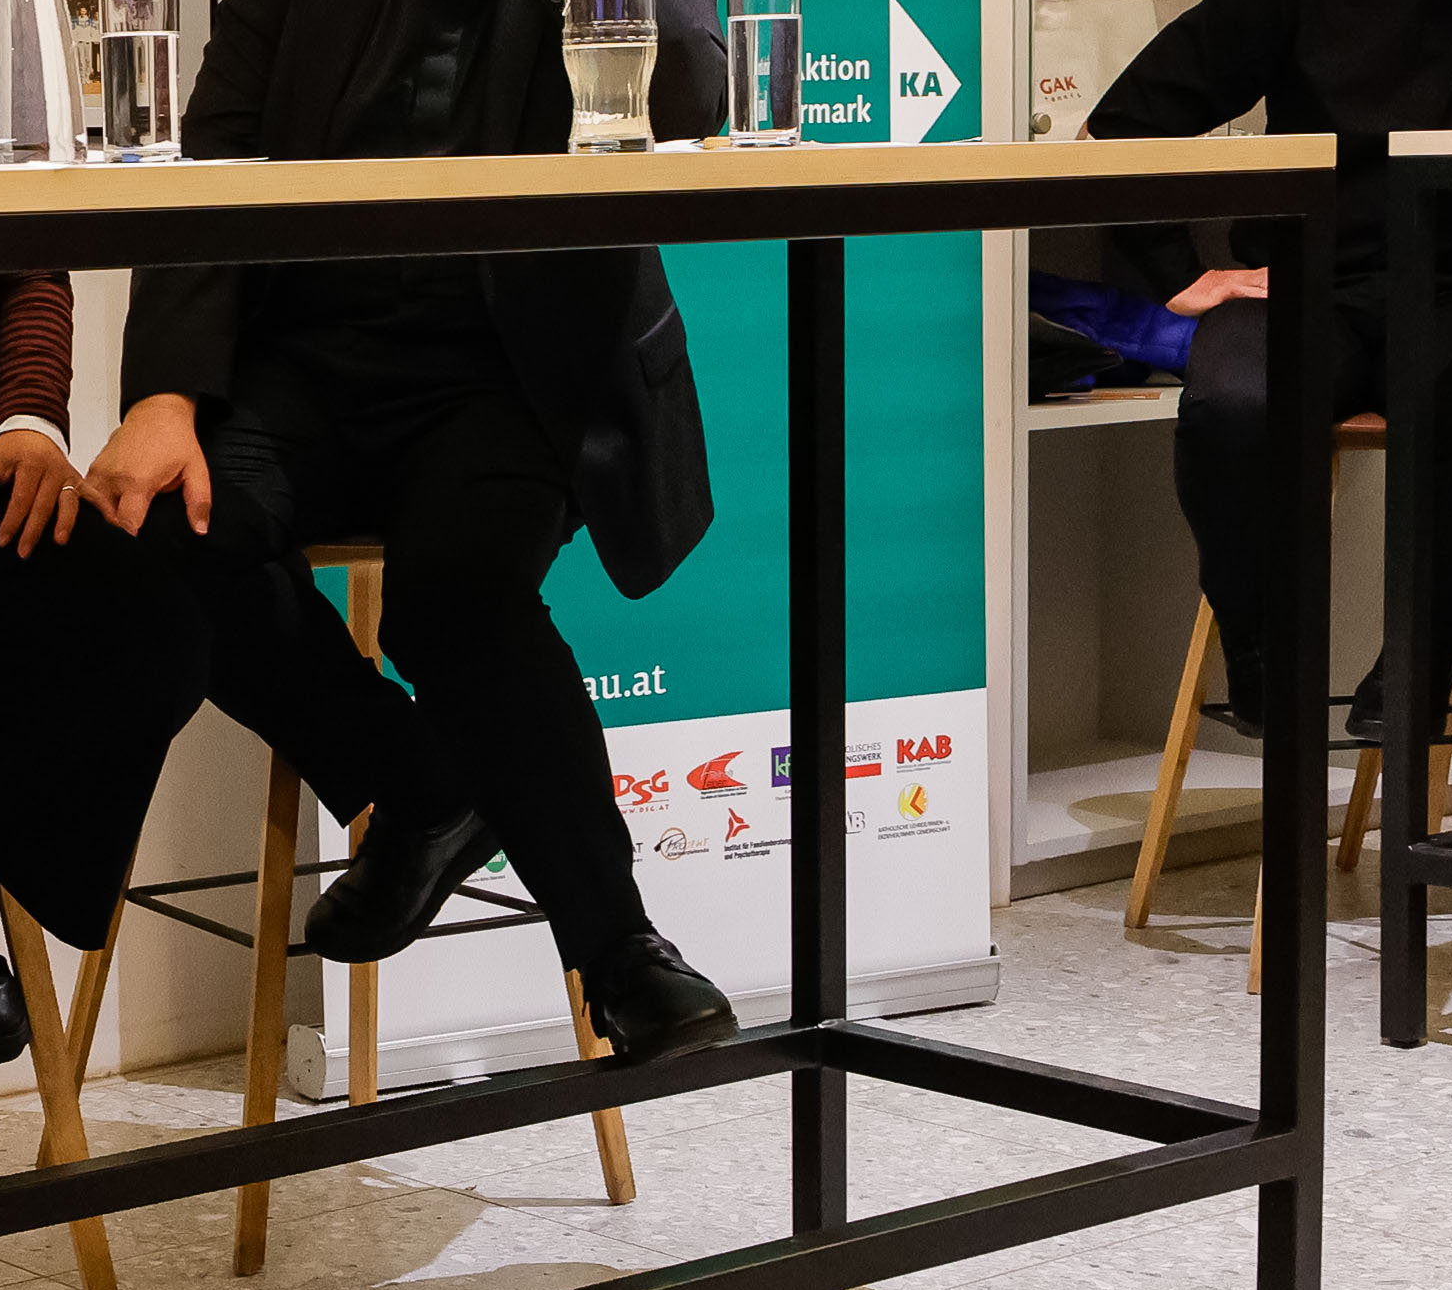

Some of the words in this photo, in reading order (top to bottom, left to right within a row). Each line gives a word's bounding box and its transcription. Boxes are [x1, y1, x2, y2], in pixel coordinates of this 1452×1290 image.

[899, 71, 943, 97] KA
[1040, 76, 1078, 95] GAK
[800, 94, 872, 124] rmark
[582, 665, 667, 701] au.at
[846, 752, 882, 763] NGSWERK
[896, 735, 953, 764] KAB
[612, 769, 669, 806] DSG
